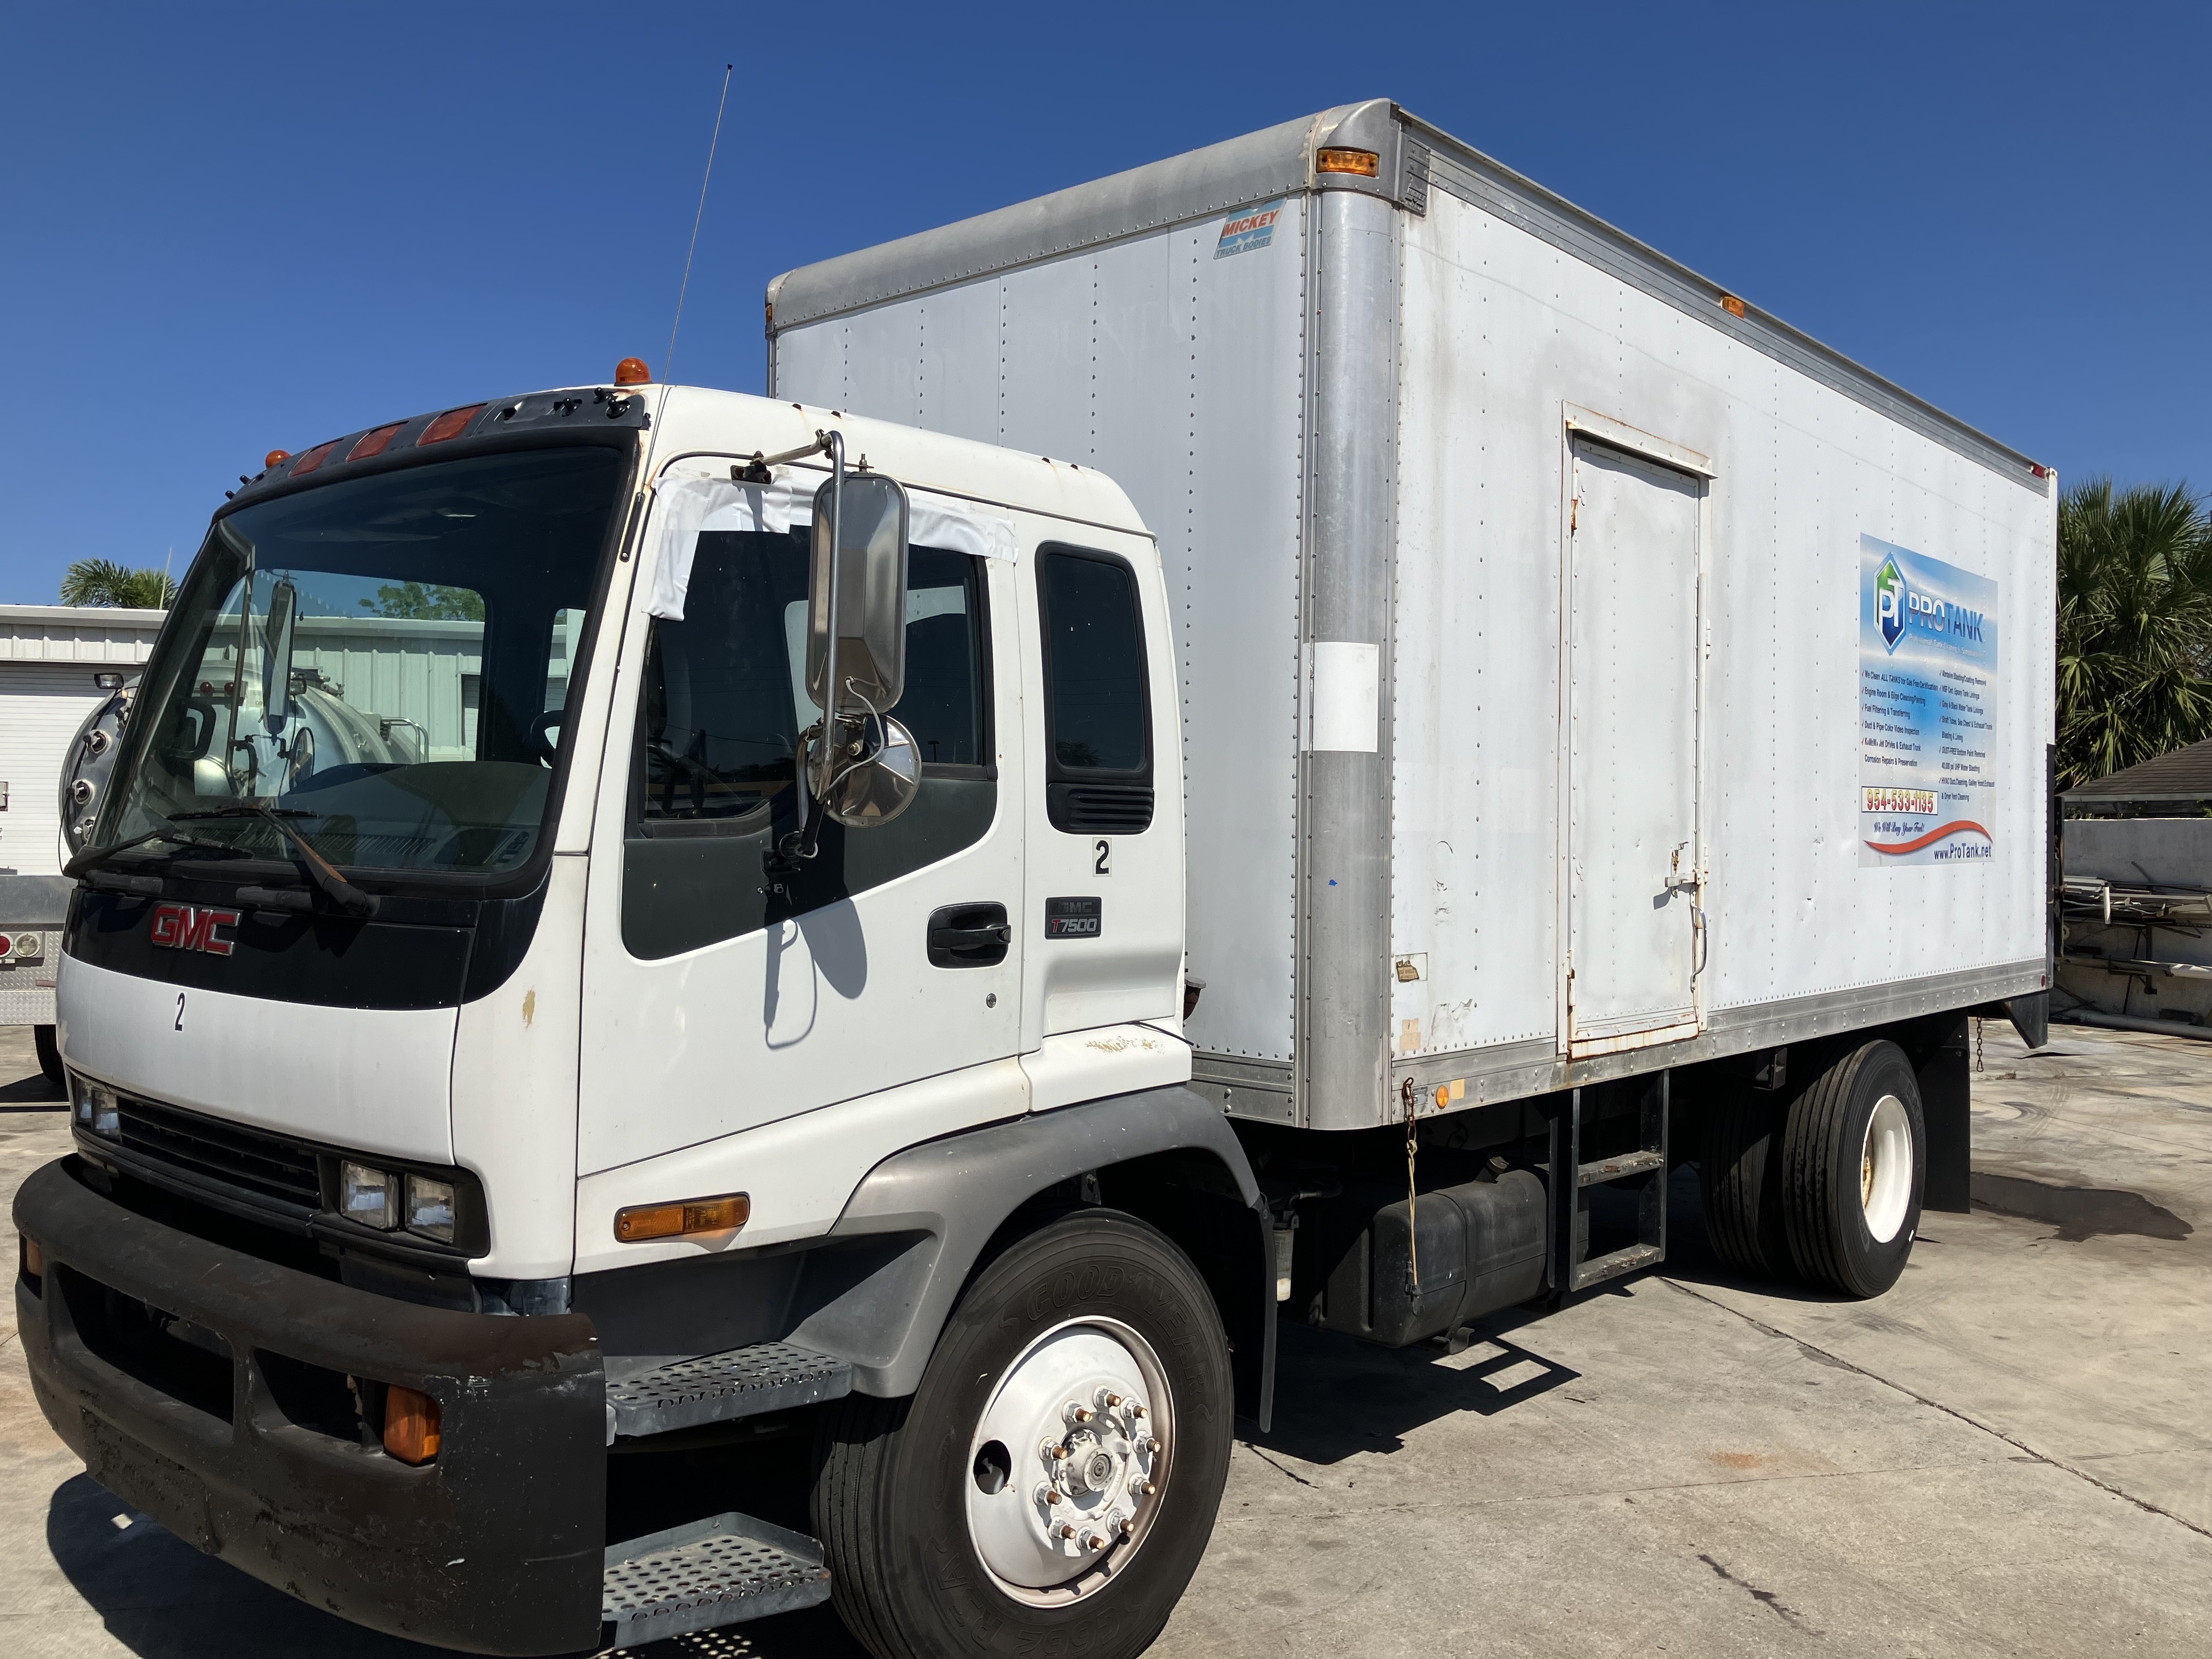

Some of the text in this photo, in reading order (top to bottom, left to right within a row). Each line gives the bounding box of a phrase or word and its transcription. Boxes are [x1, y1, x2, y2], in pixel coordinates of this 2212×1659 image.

[1222, 210, 1279, 236] MICKEY
[1216, 236, 1272, 258] TRUCK BODIES
[1908, 590, 1984, 644] PROTANK
[1865, 670, 1870, 679] We
[1871, 672, 1880, 680] Clean
[1889, 675, 1900, 684] TANKS
[1865, 687, 1876, 697] Engine
[1877, 689, 1887, 697] Room
[1891, 691, 1899, 702] Bilge
[1872, 704, 1886, 716] Filtering
[1891, 708, 1910, 720] Transferring
[1884, 724, 1893, 732] Color
[1894, 725, 1904, 733] Video
[1904, 726, 1920, 736] Inspection
[1885, 740, 1895, 749] Drives
[1899, 742, 1912, 751] Exhaust
[1865, 754, 1881, 763] Corrosion
[1882, 756, 1894, 766] Repairs
[1898, 758, 1917, 767] Preservation
[1867, 789, 1933, 812] 954-533-1135
[1874, 822, 1881, 832] We
[1882, 822, 1891, 832] Will
[1891, 822, 1901, 836] Buy
[1901, 822, 1912, 836] Your
[1095, 840, 1109, 874] 2
[1934, 843, 1991, 860] www.ProTank.net
[1058, 901, 1092, 913] GMC
[150, 905, 241, 956] GMC
[1051, 918, 1097, 933] T7500
[174, 992, 185, 1031] 2
